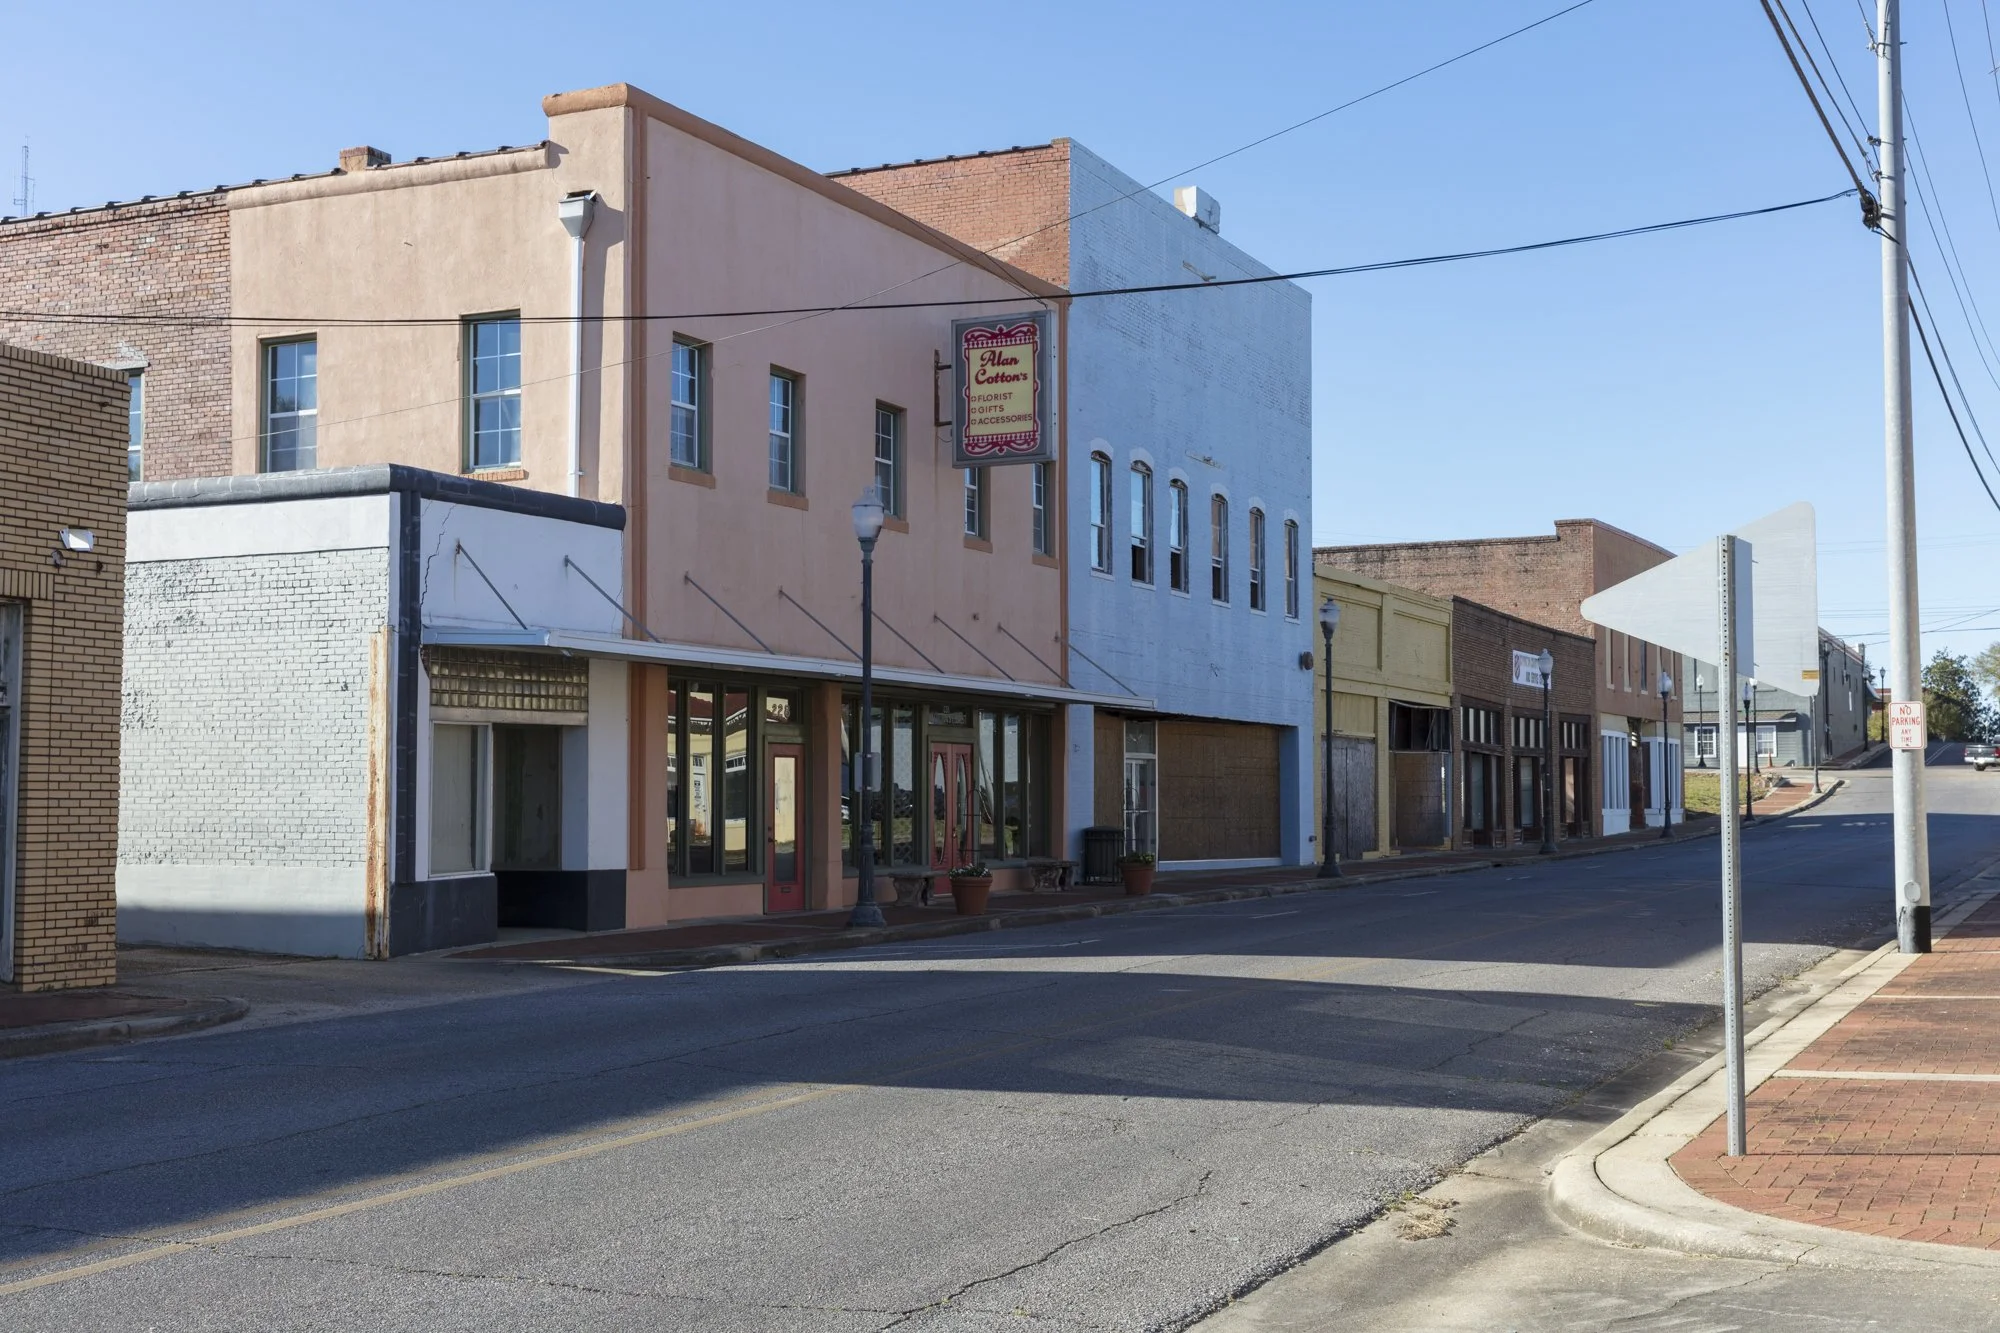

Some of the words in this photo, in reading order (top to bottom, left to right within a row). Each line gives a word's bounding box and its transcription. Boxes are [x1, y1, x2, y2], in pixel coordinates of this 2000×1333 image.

[980, 350, 1019, 367] Alan
[975, 368, 1028, 385] Cotton's
[977, 392, 1013, 402] FLORIST
[978, 405, 1005, 414] GIFTS
[977, 413, 1033, 425] ACCESSORIES
[1899, 706, 1912, 716] NO
[1891, 716, 1921, 726] PARKING
